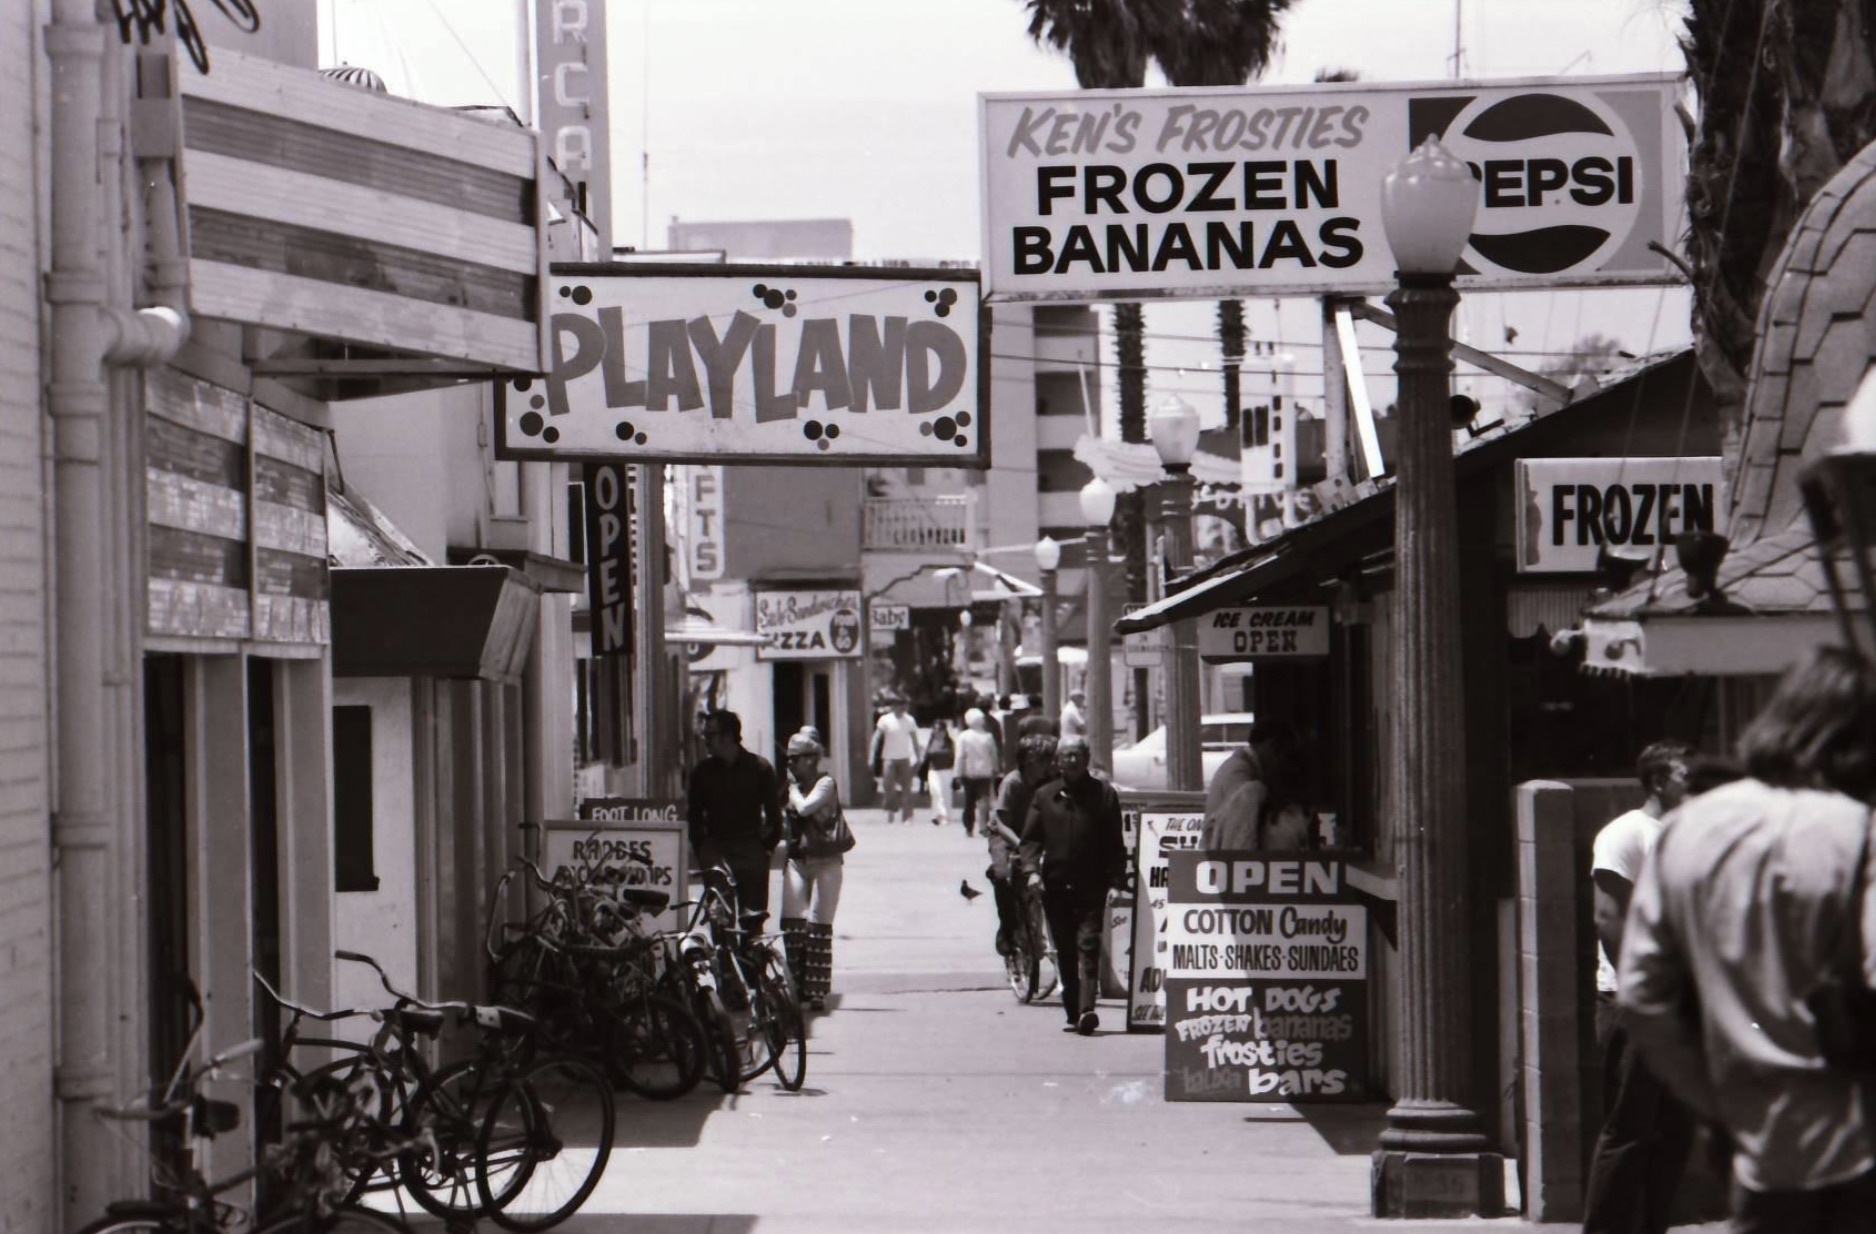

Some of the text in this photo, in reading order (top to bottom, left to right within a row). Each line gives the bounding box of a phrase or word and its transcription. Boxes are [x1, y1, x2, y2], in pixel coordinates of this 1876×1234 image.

[1006, 103, 1369, 159] KEN'S FROSTIES
[1037, 159, 1339, 215] FROZEN
[1467, 156, 1634, 207] EPSI
[1012, 217, 1363, 275] BANANAS
[546, 306, 968, 423] PLAYLAND
[1552, 484, 1715, 545] FROZEN
[595, 466, 625, 650] OPEN
[1213, 611, 1315, 628] ICE CREAM
[1234, 630, 1297, 653] OPEN
[592, 804, 679, 821] FOOT LONG
[1196, 861, 1338, 894] OPEN
[1184, 909, 1273, 935] COTTON
[1279, 906, 1348, 944] Candy
[1187, 985, 1341, 1013] HOT DOGS
[1174, 1006, 1353, 1042] FROZEN bananas
[1200, 1034, 1323, 1069] frosties
[1248, 1068, 1348, 1096] bars
